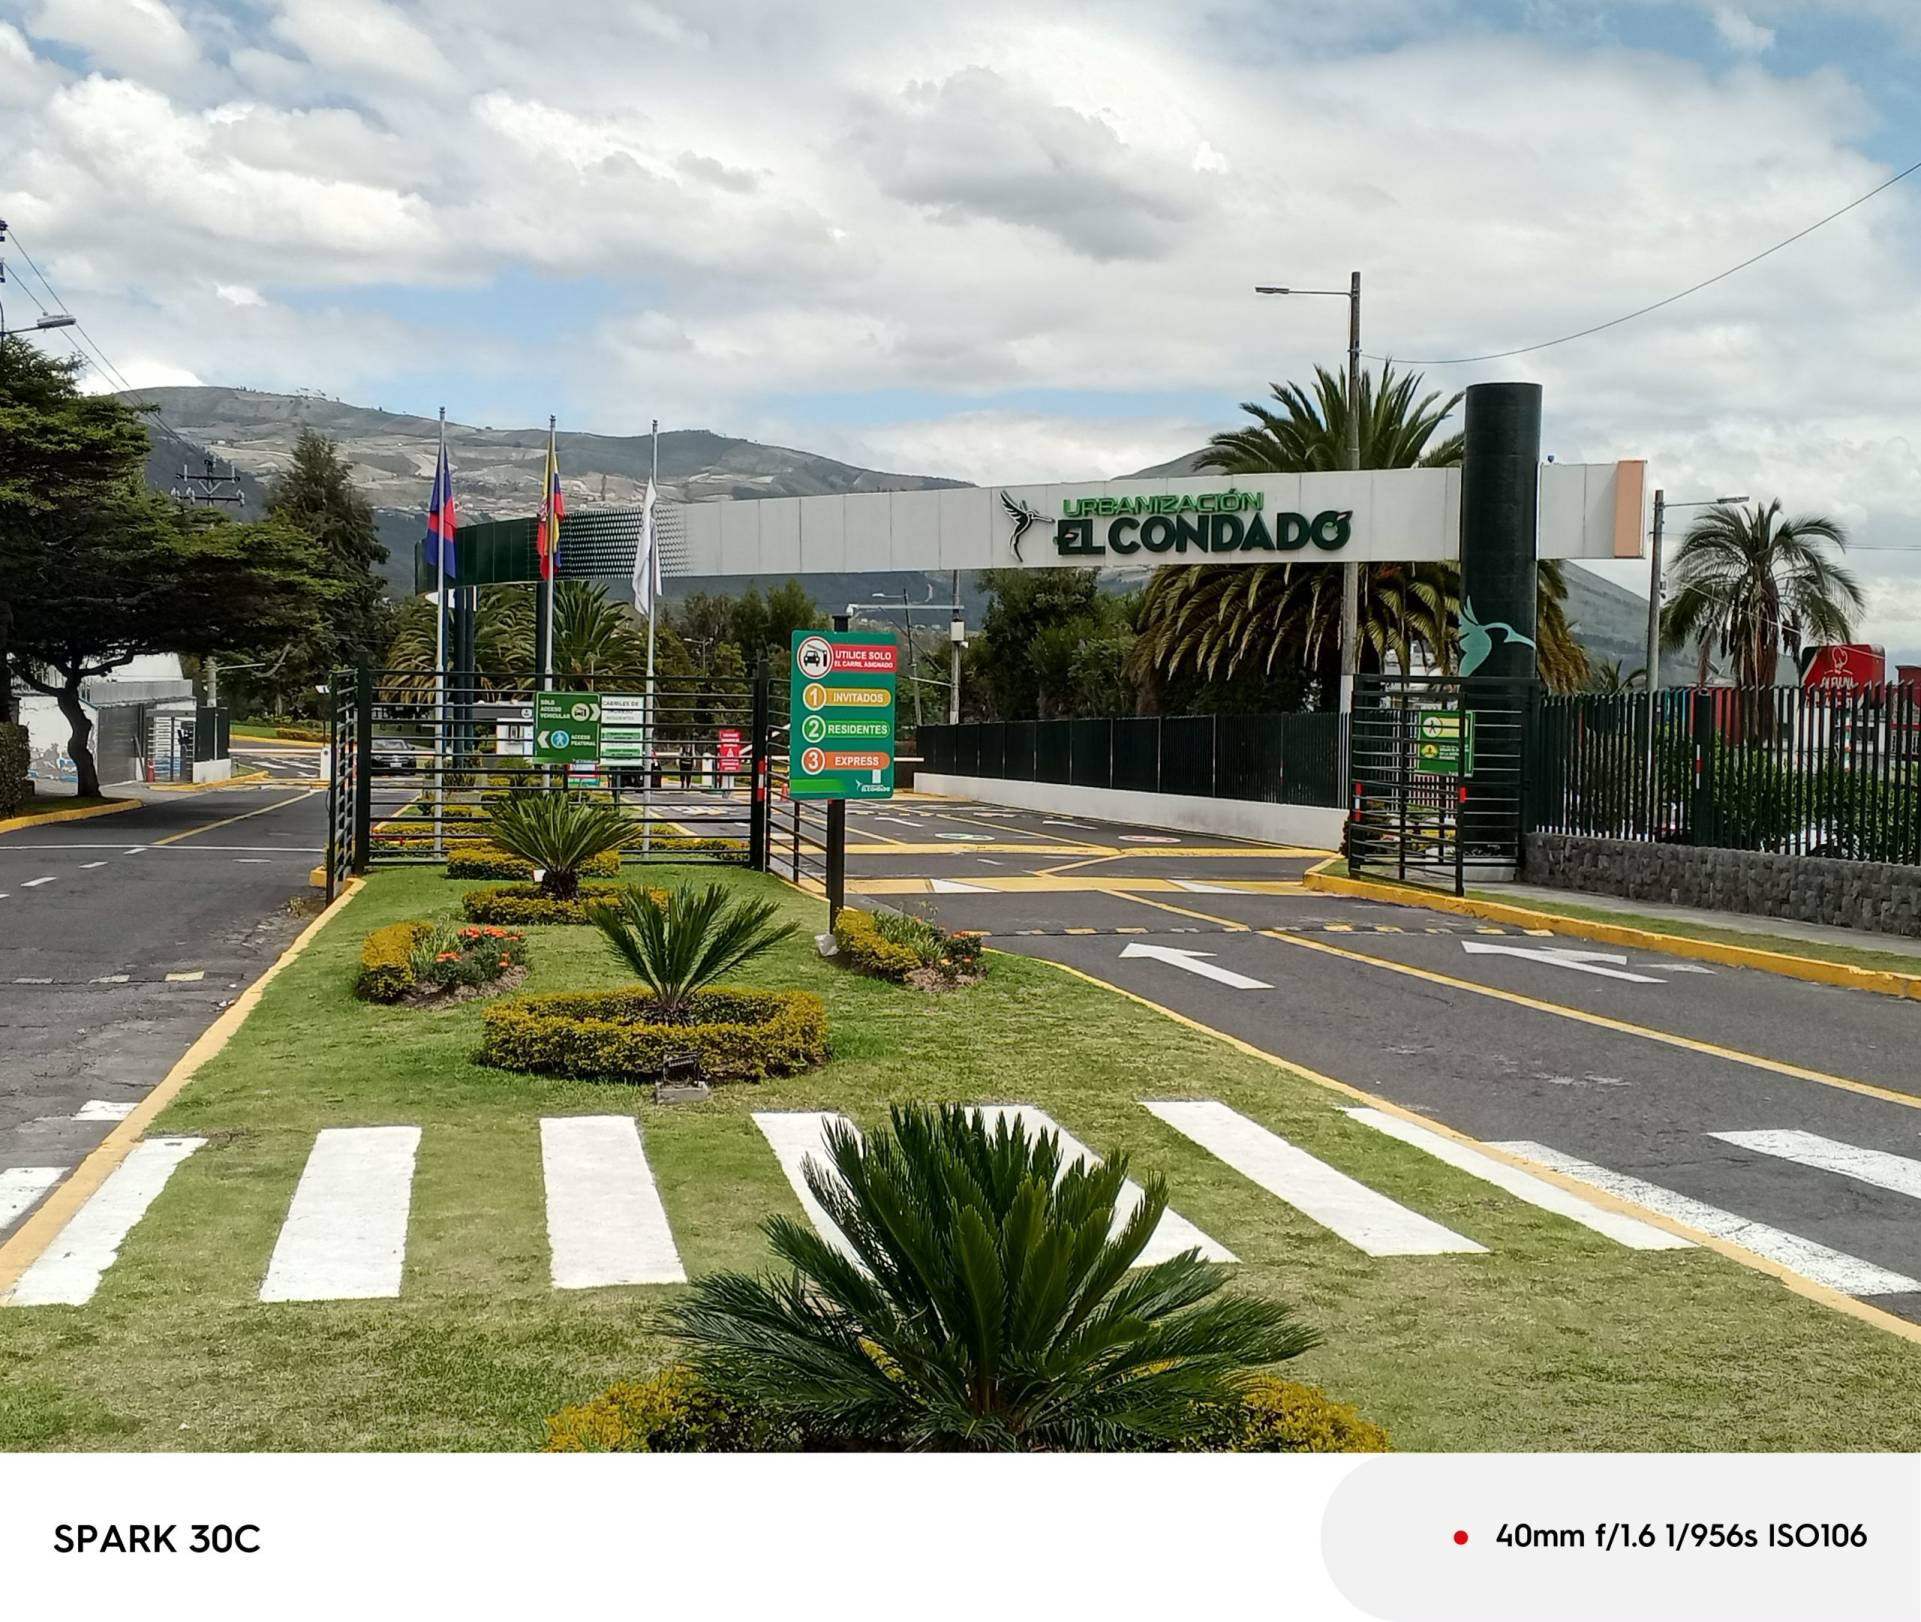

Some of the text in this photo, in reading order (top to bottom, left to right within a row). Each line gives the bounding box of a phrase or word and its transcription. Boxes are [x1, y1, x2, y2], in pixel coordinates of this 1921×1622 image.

[1062, 488, 1264, 517] URBANIZACIÓN
[1056, 510, 1353, 555] EL CONDADO
[835, 650, 892, 661] UTILICE SOLO
[810, 688, 884, 706] 1 INVITADOS
[808, 720, 888, 738] 2 RESIDENTES
[808, 752, 880, 770] 3 EXPRESS
